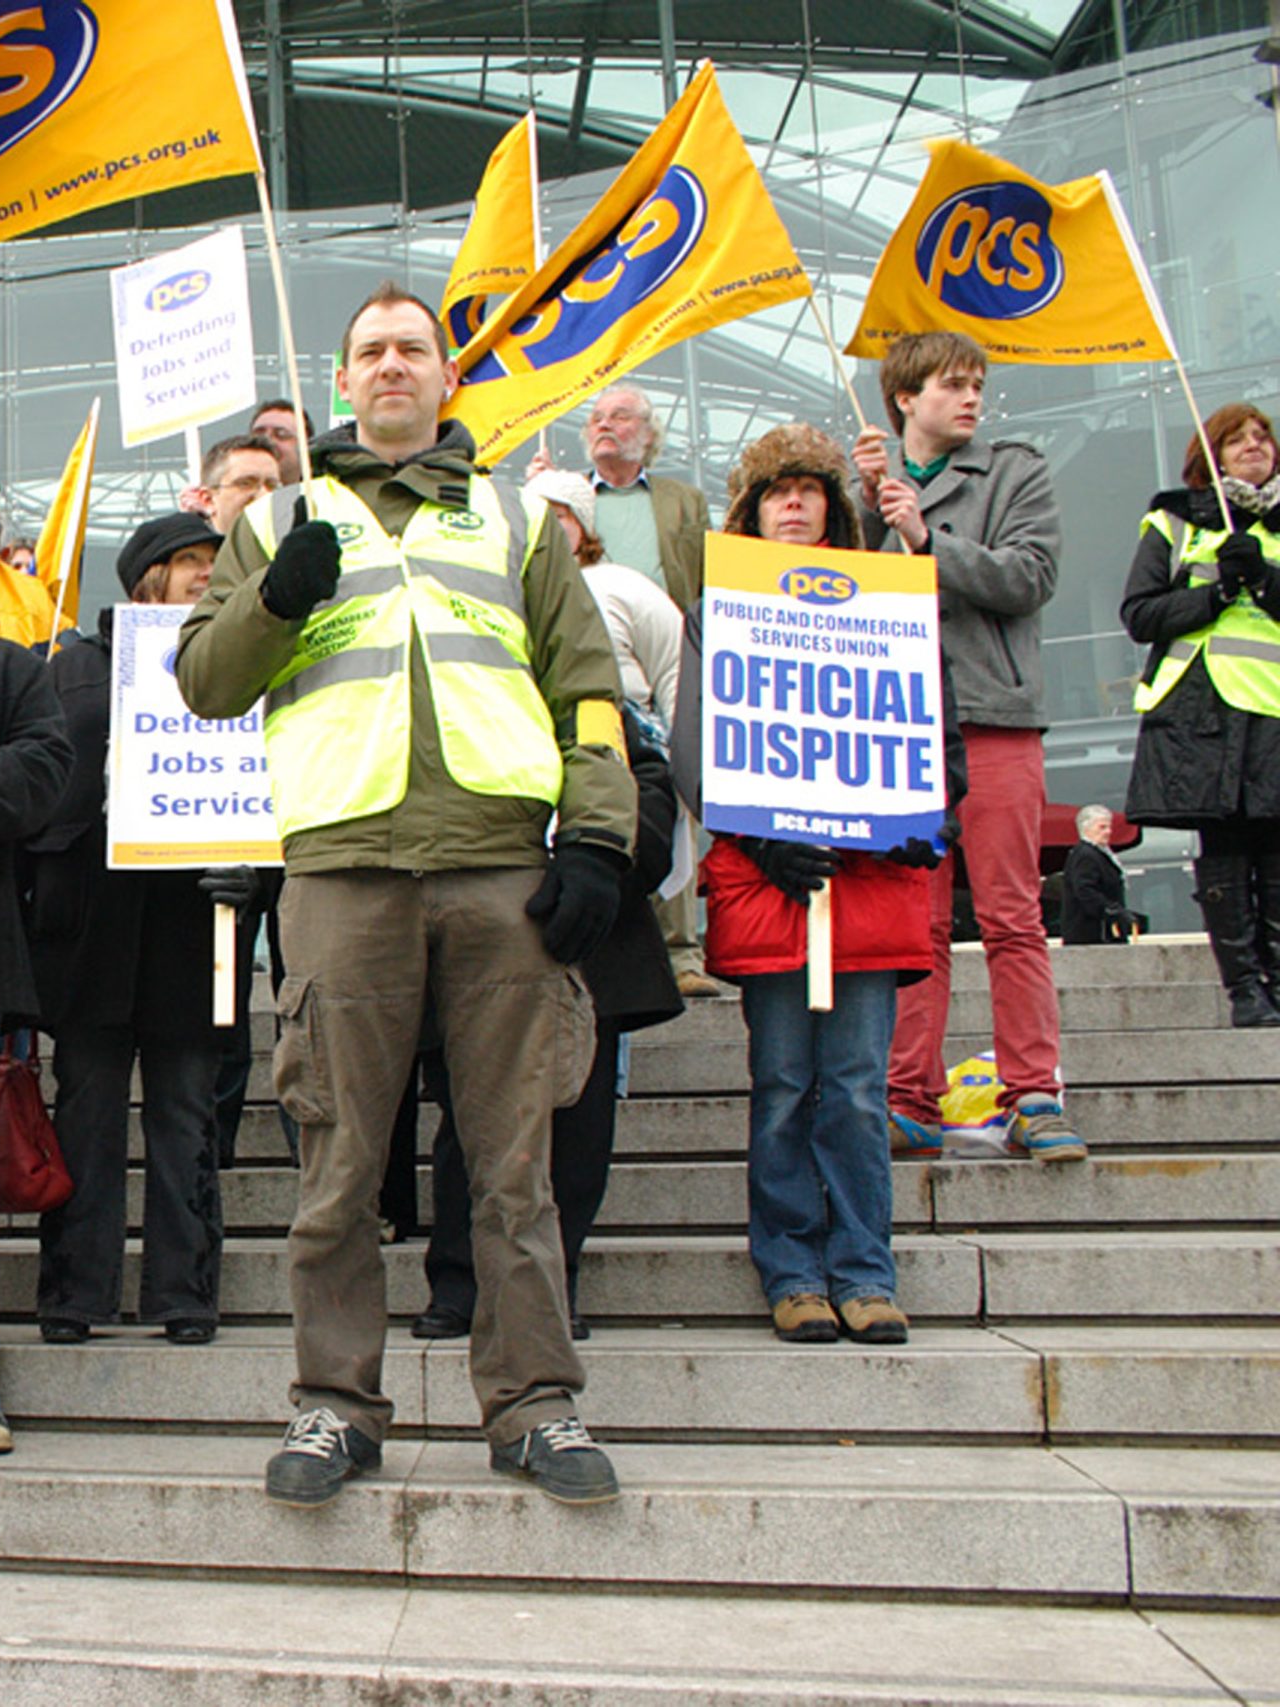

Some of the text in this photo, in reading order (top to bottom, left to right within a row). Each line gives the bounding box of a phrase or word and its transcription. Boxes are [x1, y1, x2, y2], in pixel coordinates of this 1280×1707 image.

[44, 128, 221, 200] www.pcs.org.uk
[927, 201, 1046, 300] pcs
[152, 272, 207, 311] pcs
[130, 311, 236, 356] Defending
[141, 338, 232, 380] Jobs and
[145, 370, 231, 407] Services
[789, 573, 852, 599] pcs
[713, 599, 929, 639] PUBLIC AND COMMERCIAL
[750, 627, 890, 657] SERVICES UNION
[712, 650, 935, 725] OFFICIAL
[147, 751, 224, 775] Jobs
[713, 714, 934, 792] DISPUTE
[773, 813, 872, 839] pcs.org.uk
